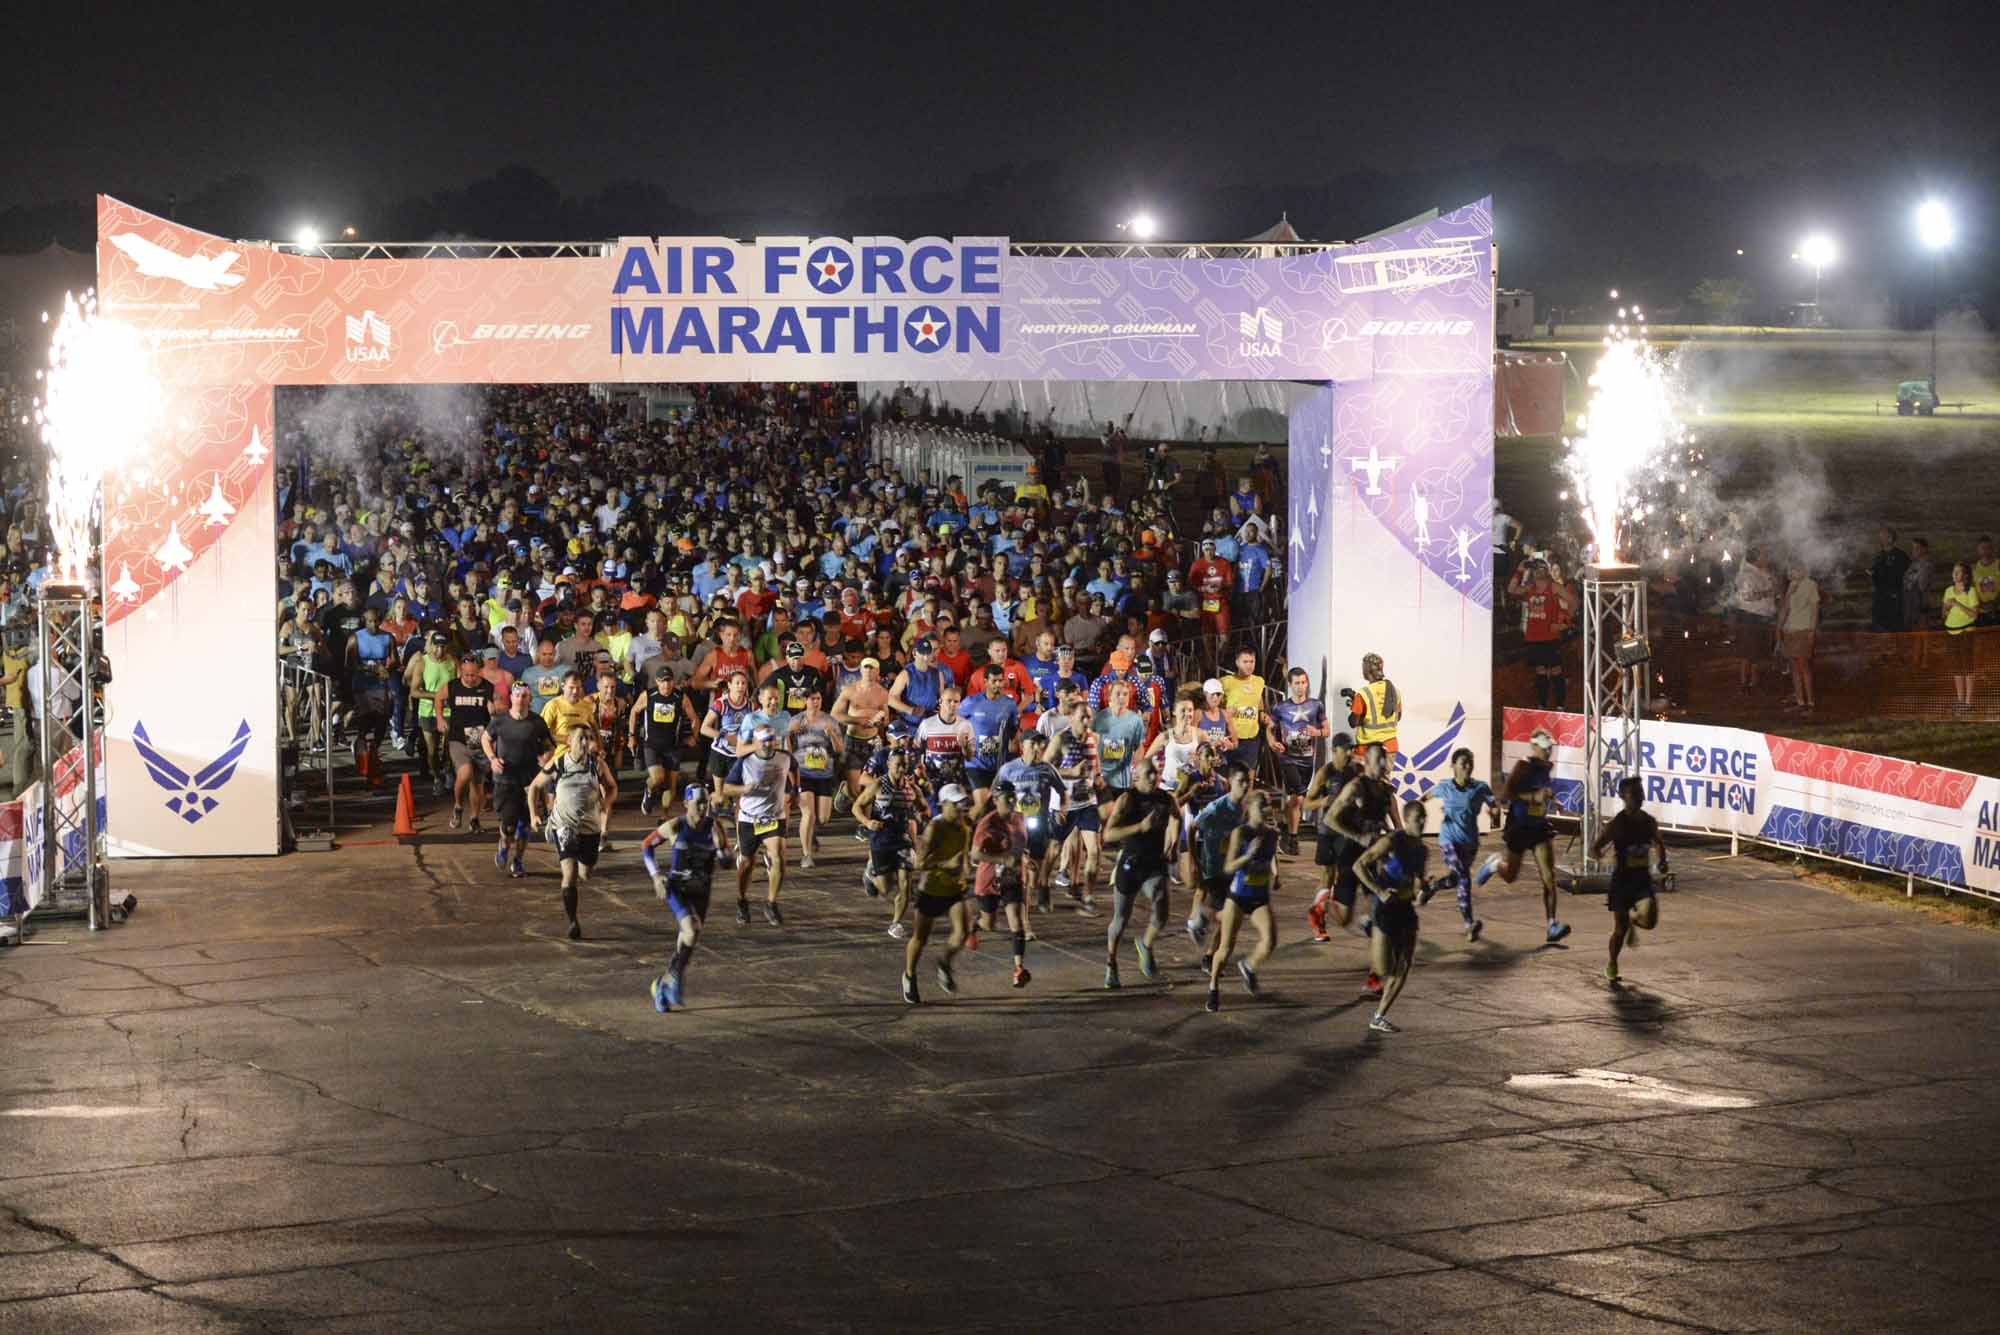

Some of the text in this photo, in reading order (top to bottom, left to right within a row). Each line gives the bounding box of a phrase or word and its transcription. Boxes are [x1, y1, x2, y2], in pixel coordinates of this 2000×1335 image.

[612, 245, 1000, 294] AIR FORCE
[471, 323, 593, 340] BOEING
[610, 305, 1000, 353] MARATHON
[1020, 323, 1197, 334] NORTHROP GRUMMAN
[1359, 320, 1474, 335] BOEING
[346, 346, 391, 361] USAA
[1239, 342, 1282, 357] USAA
[1604, 738, 1758, 781] AIR FORCE
[1600, 770, 1757, 816] MRATHON
